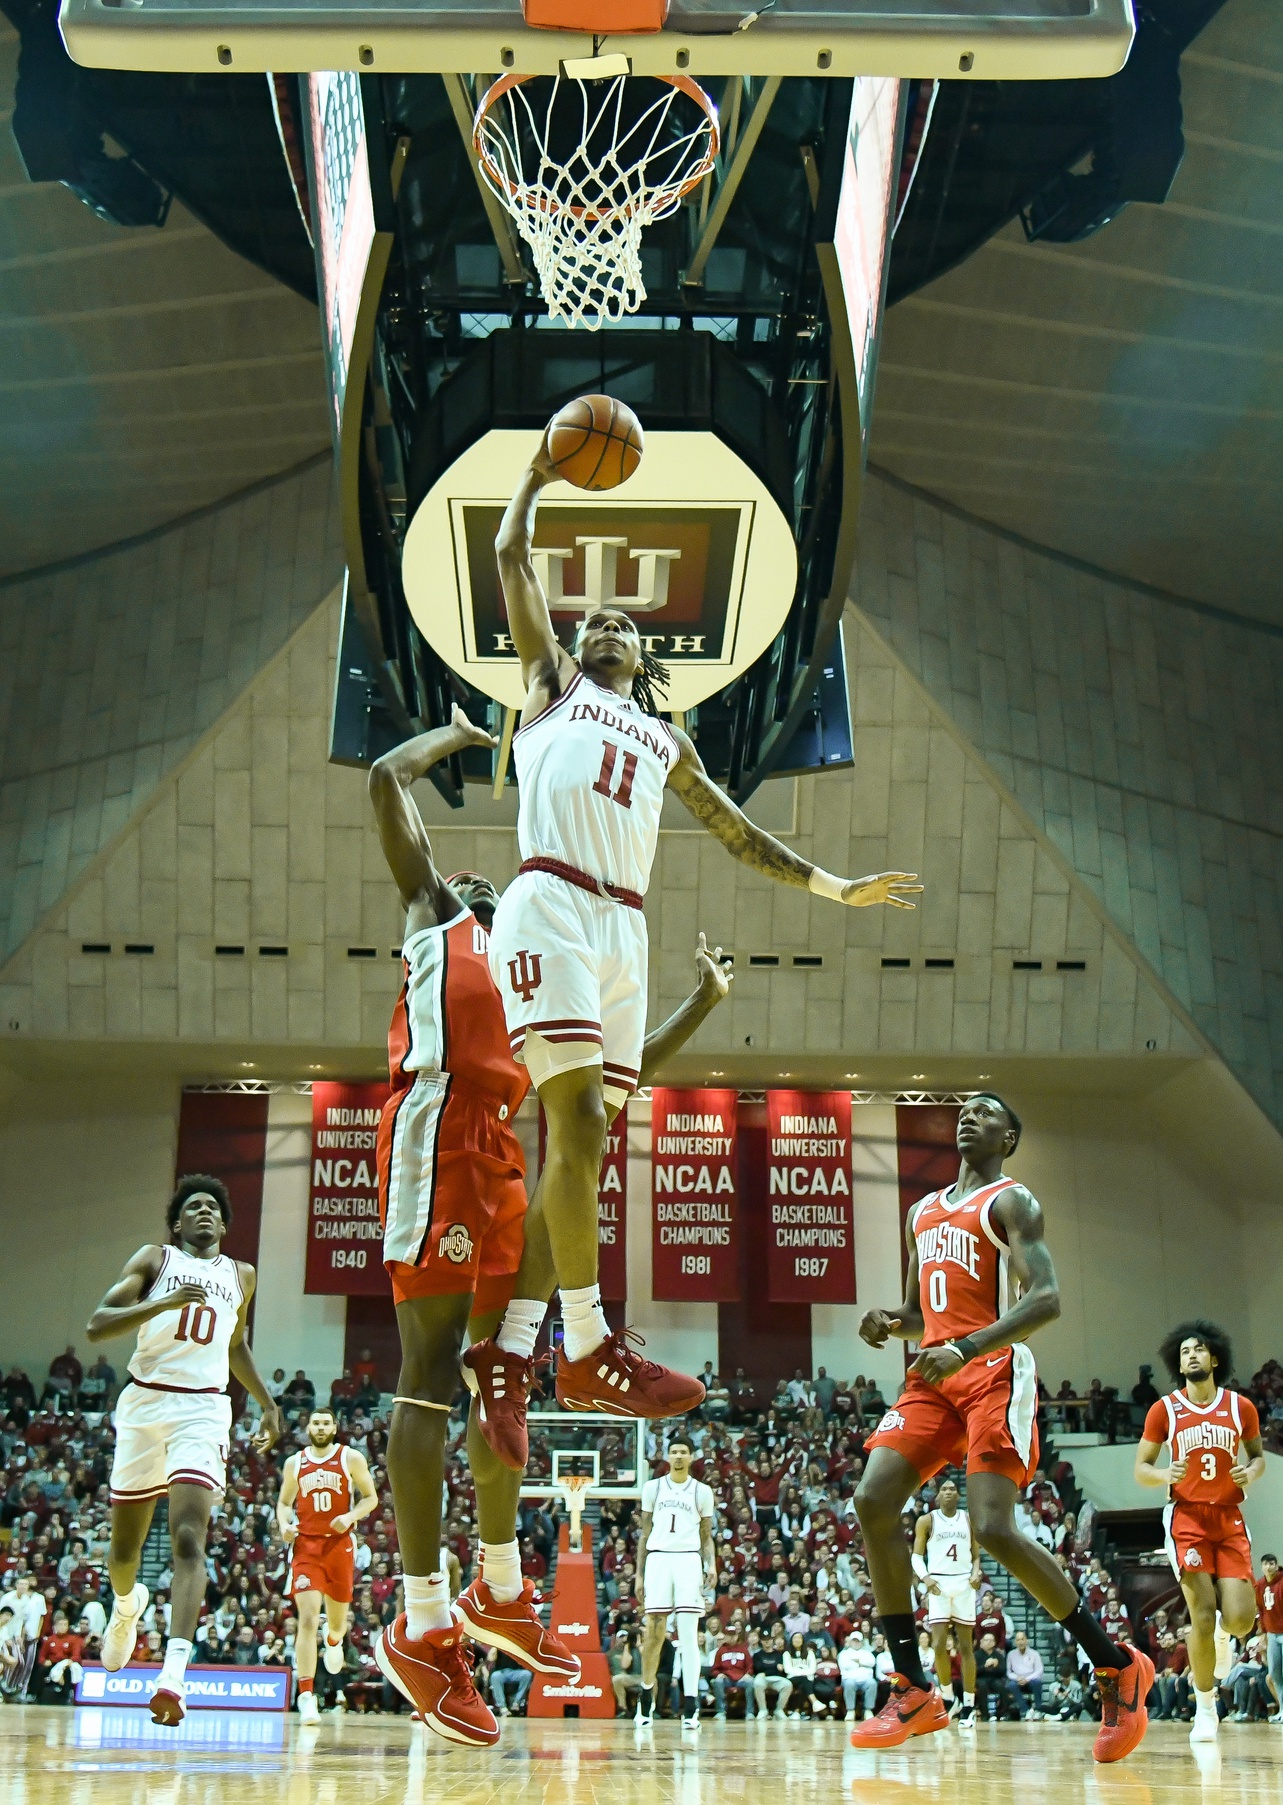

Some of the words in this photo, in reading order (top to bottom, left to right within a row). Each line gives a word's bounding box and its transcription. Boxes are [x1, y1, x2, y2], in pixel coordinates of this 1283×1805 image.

[493, 634, 706, 652] HTH
[569, 704, 670, 771] INDIANA
[592, 739, 638, 809] 11
[507, 950, 542, 1002] IU
[667, 1114, 724, 1134] INDIANA
[780, 1116, 838, 1134] INDIANA
[317, 1131, 378, 1149] UNIVERSI
[657, 1137, 733, 1156] UNIVERSITY
[771, 1138, 846, 1157] UNIVERSITY
[655, 1164, 735, 1194] NCAA
[769, 1166, 850, 1196] NCAA
[313, 1197, 380, 1217] BASKETBAL
[657, 1203, 733, 1222] BASKETBALL
[772, 1205, 848, 1224] BASKETBALL
[315, 1220, 384, 1240] CHAMPIONS
[660, 1227, 730, 1245] CHAMPIONS
[776, 1228, 846, 1248] CHAMPIONS
[331, 1250, 367, 1268] 1940
[681, 1255, 711, 1275] 1981
[794, 1258, 829, 1277] 1987
[929, 1269, 948, 1313] 0
[174, 1304, 217, 1345] 10
[1200, 1453, 1217, 1481] 3
[312, 1491, 332, 1513] 10
[669, 1513, 676, 1533] 1
[946, 1543, 958, 1562] 4
[106, 1679, 143, 1693] OLD
[230, 1682, 278, 1698] BANK
